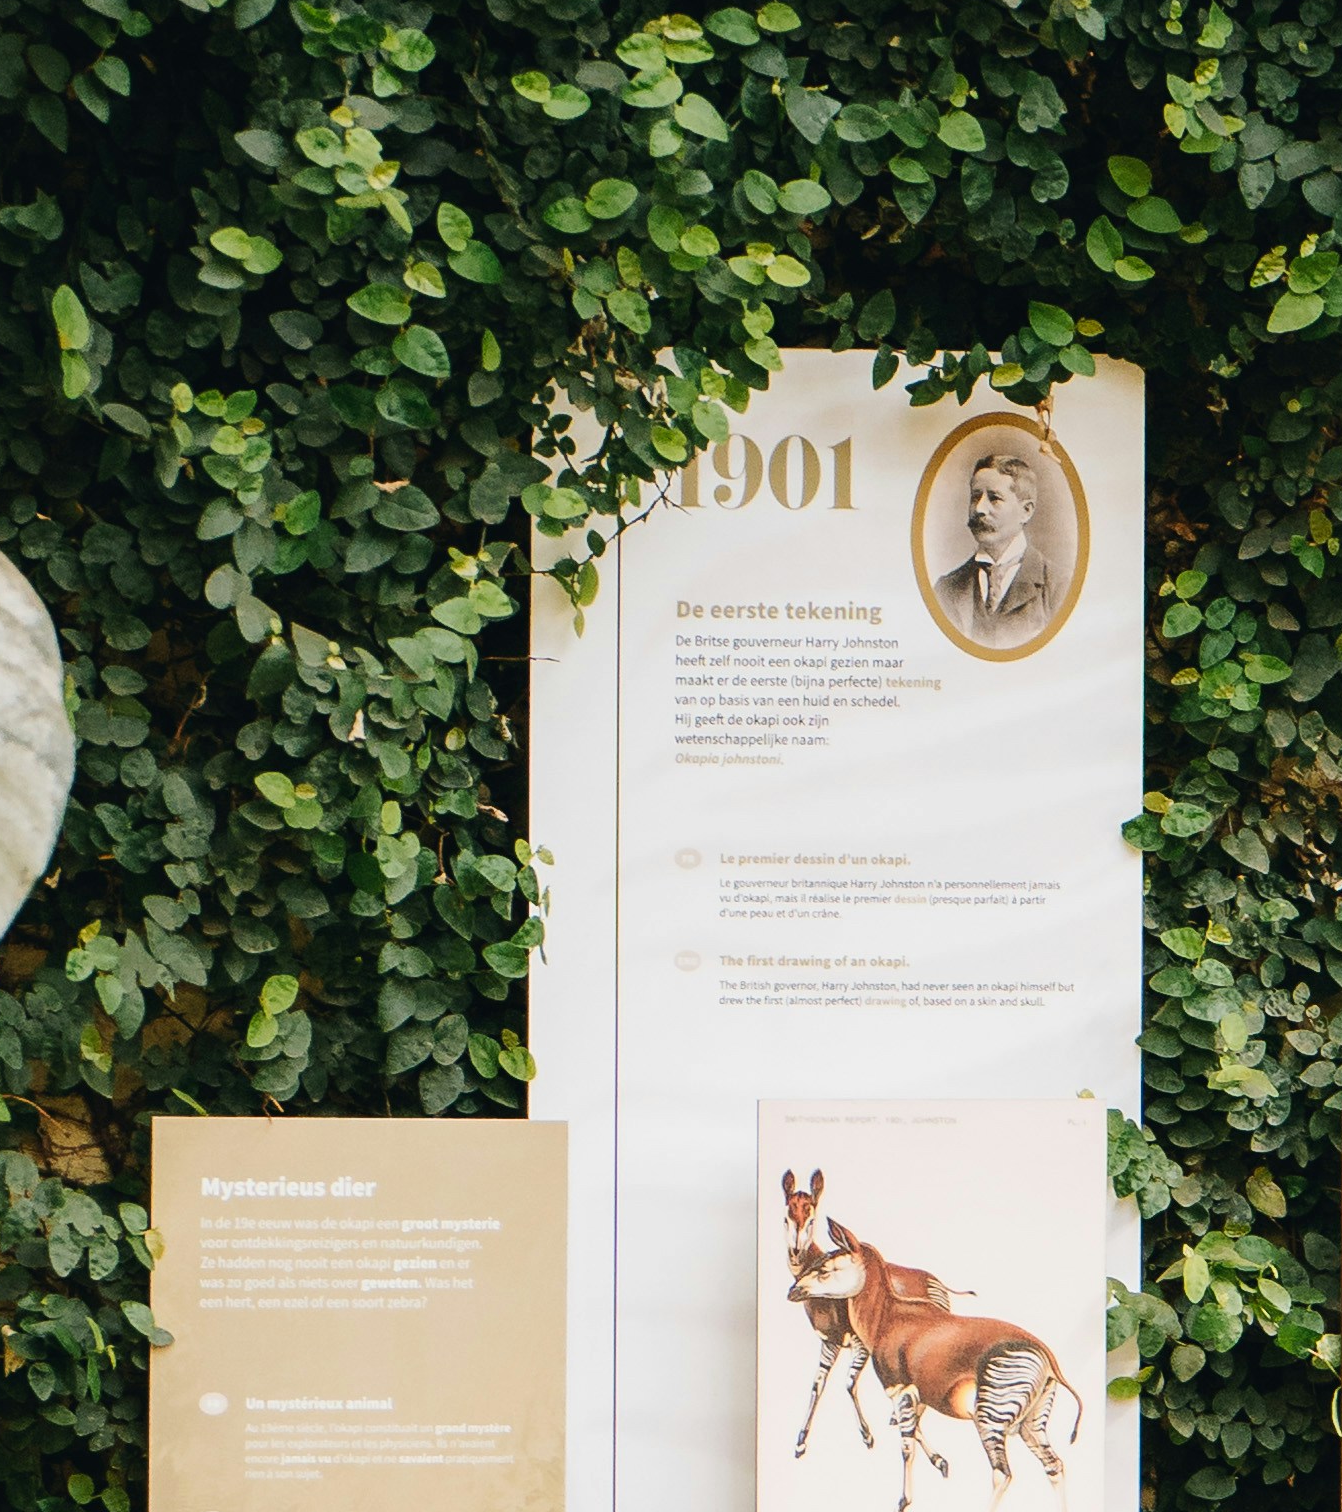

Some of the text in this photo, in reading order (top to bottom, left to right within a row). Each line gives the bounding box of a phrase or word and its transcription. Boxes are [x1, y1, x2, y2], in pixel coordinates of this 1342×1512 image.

[680, 433, 858, 510] 1901
[676, 601, 883, 625] De eerste tekening
[675, 635, 899, 652] De Britse gouverneur Harry Johnston
[675, 654, 903, 671] heeft zelf nooit een okapi gezien maar
[675, 674, 942, 692] maakt er de eerste (bijna perfecte) tekening
[674, 697, 697, 707] van
[699, 697, 716, 710] op
[718, 694, 750, 707] basis
[752, 697, 774, 707] van
[777, 697, 800, 707] een
[802, 695, 830, 707] huid
[832, 698, 848, 708] en
[674, 713, 829, 730] Hij geeft de okapi ook zijn
[674, 733, 788, 749] wetenschappelijke
[674, 752, 720, 768] Okapia
[720, 853, 735, 865] Le
[738, 853, 790, 868] premier
[793, 853, 835, 866] dessin
[720, 954, 744, 967] The
[747, 954, 775, 967] first
[777, 955, 831, 971] drawing
[834, 955, 847, 968] of
[850, 958, 867, 968] an
[201, 1176, 377, 1201] Mysterieus dier
